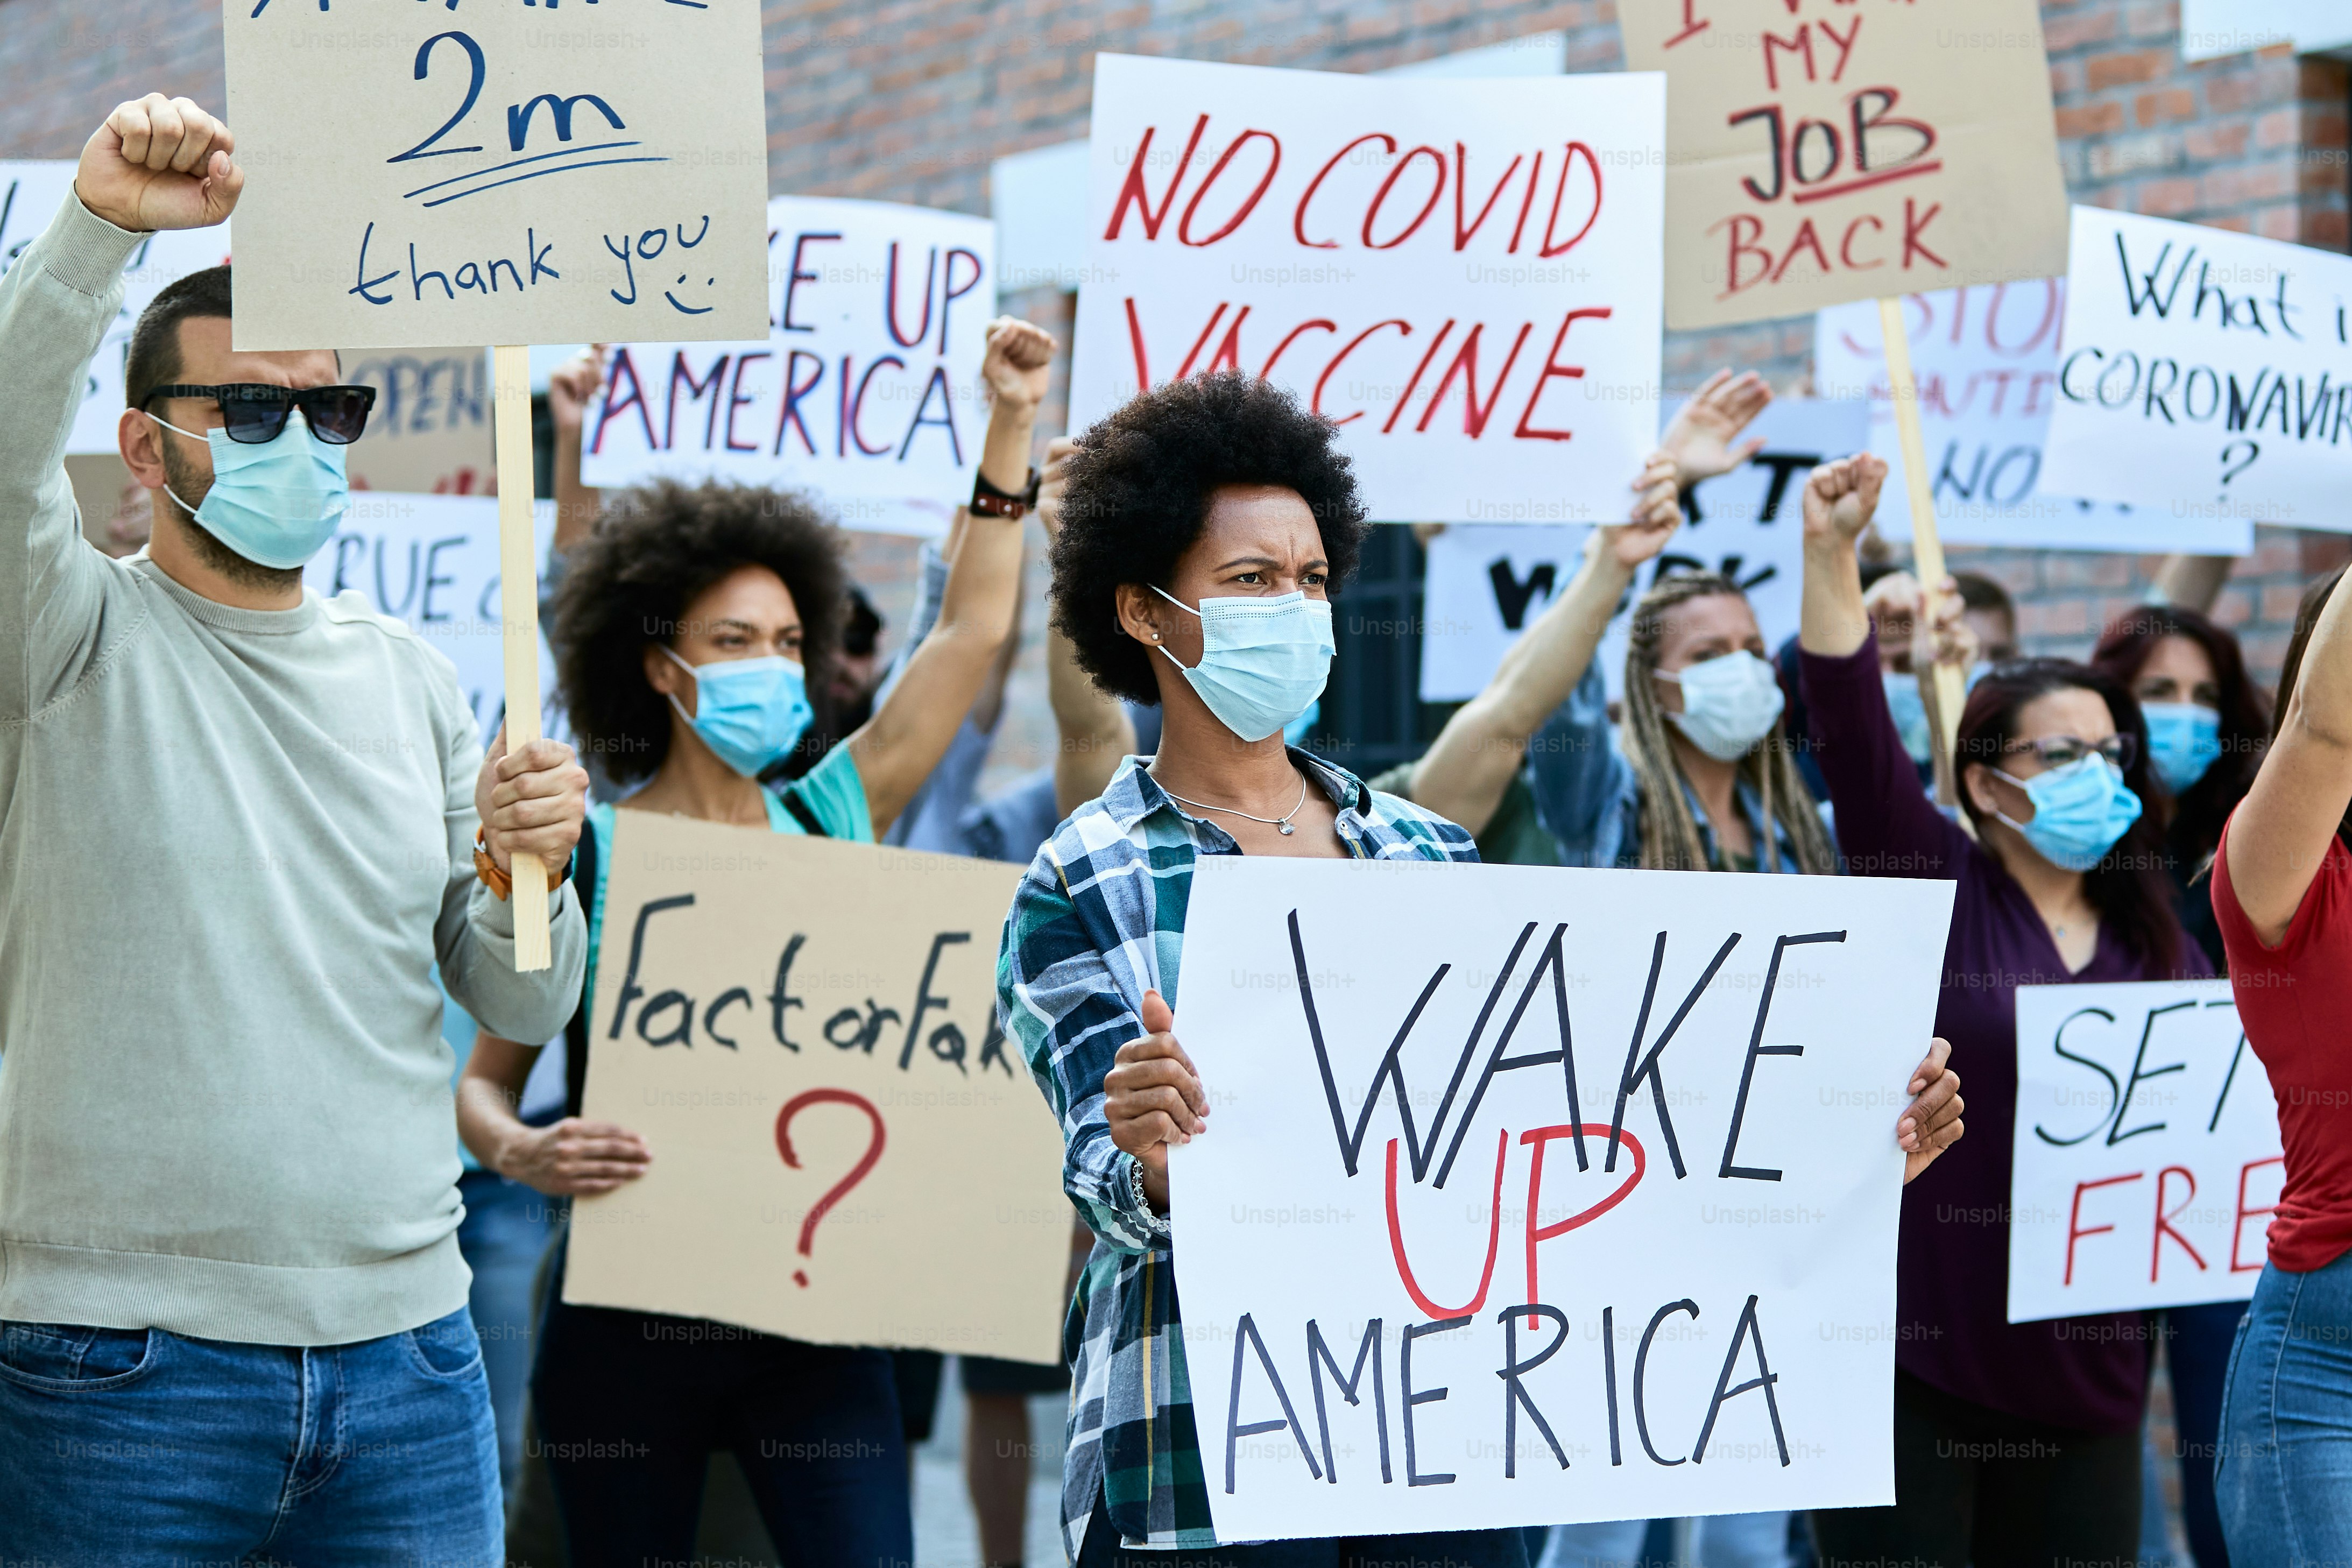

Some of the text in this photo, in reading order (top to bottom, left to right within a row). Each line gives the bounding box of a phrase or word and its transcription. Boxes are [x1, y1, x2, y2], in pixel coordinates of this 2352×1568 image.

[1761, 15, 1862, 90] MY
[1103, 112, 1602, 259] NO COVID
[1728, 86, 1938, 202] JOB
[348, 215, 710, 305] thank you
[888, 242, 983, 356] UP
[1707, 197, 1950, 302] BACK
[2114, 230, 2306, 342] What
[590, 347, 963, 467] AMERICA
[2220, 441, 2259, 502] ?
[608, 894, 807, 1053] Fact
[823, 999, 902, 1055] or
[1288, 908, 1847, 1189] WAKE
[2035, 1000, 2245, 1147] SET
[775, 1087, 887, 1288] ?
[1385, 1123, 1646, 1330] UP
[1225, 1295, 1790, 1494] AMERICA
